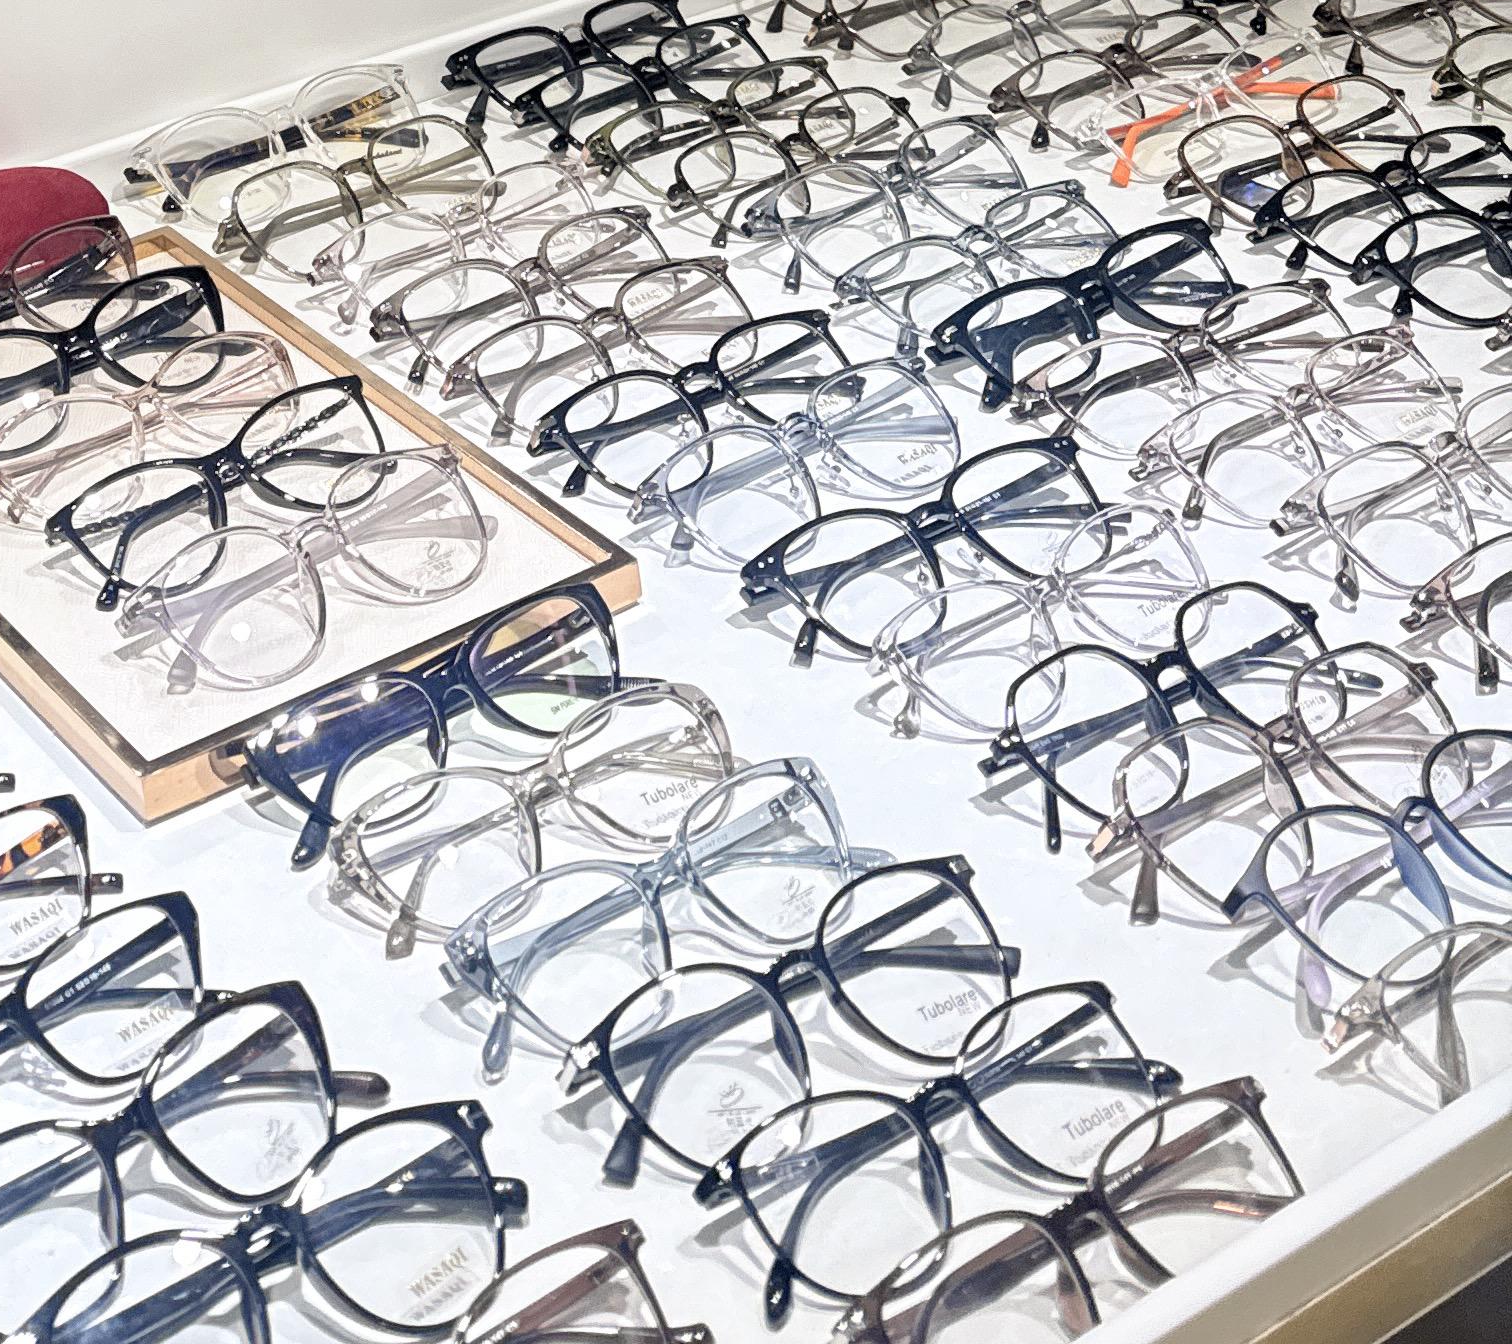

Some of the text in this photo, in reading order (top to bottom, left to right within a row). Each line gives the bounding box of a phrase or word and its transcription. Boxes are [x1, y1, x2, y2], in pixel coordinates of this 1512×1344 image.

[640, 776, 700, 807] Tubolare
[916, 989, 978, 1023] Tubolare
[1061, 1099, 1126, 1140] Tubolare
